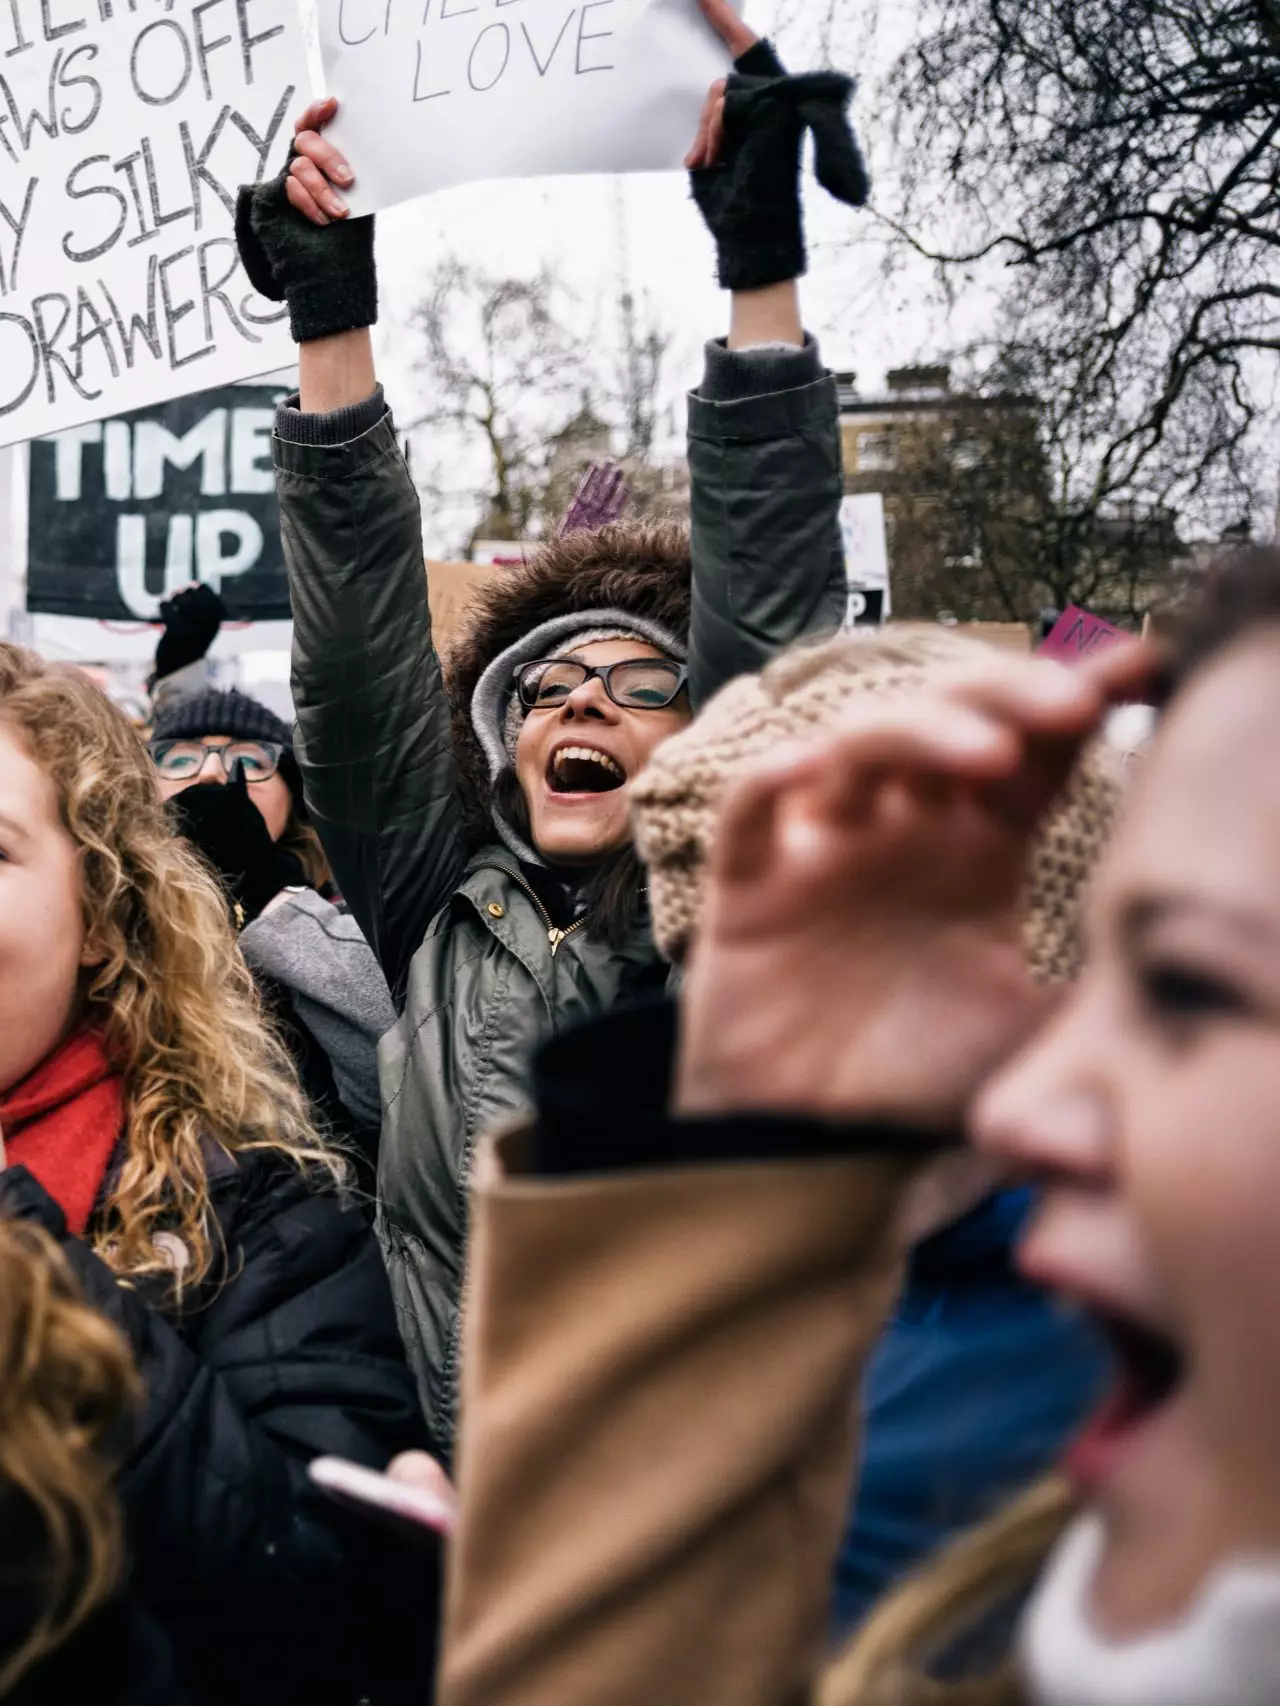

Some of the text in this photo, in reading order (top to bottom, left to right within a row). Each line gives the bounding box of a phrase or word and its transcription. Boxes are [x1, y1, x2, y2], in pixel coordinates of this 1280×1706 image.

[131, 0, 285, 106] OFF
[412, 0, 614, 102] LOVE
[62, 85, 296, 266] SILKY
[117, 508, 264, 620] UP
